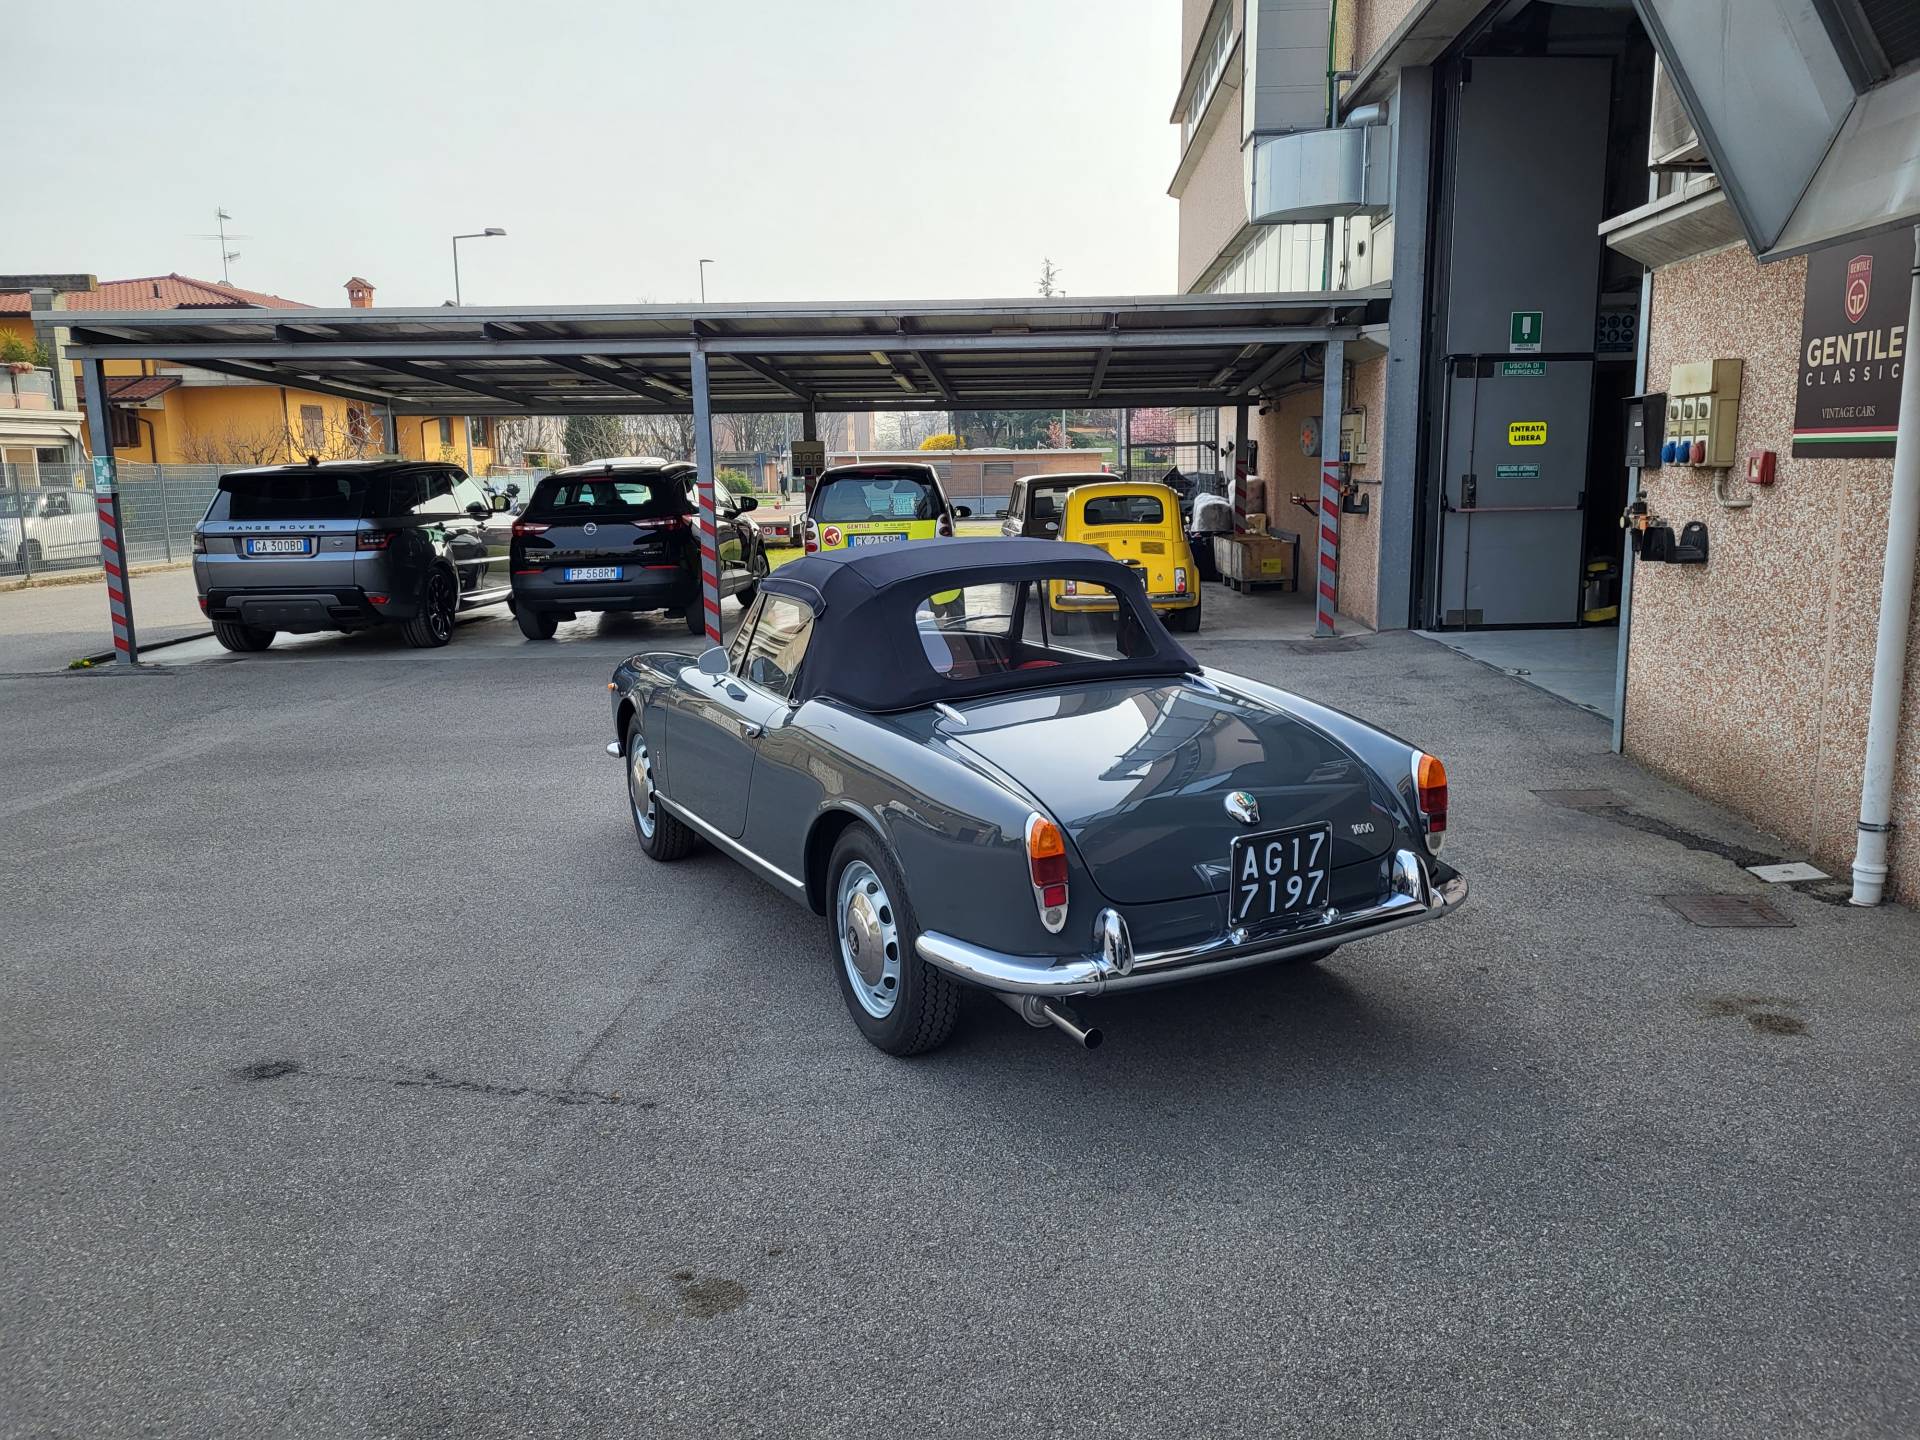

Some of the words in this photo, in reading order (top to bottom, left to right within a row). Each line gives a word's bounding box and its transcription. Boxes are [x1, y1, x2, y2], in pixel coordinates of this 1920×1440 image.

[1806, 326, 1905, 368] GENTILE
[1805, 363, 1900, 386] CLASSIC
[1822, 407, 1855, 419] VINTAGE
[1856, 405, 1876, 418] CARS
[1511, 425, 1545, 433] ENTRATA
[1514, 434, 1541, 442] LIBERA
[571, 569, 583, 579] FP
[1351, 822, 1375, 835] 1600
[1242, 832, 1325, 881] AG17
[1240, 869, 1324, 918] 7197
